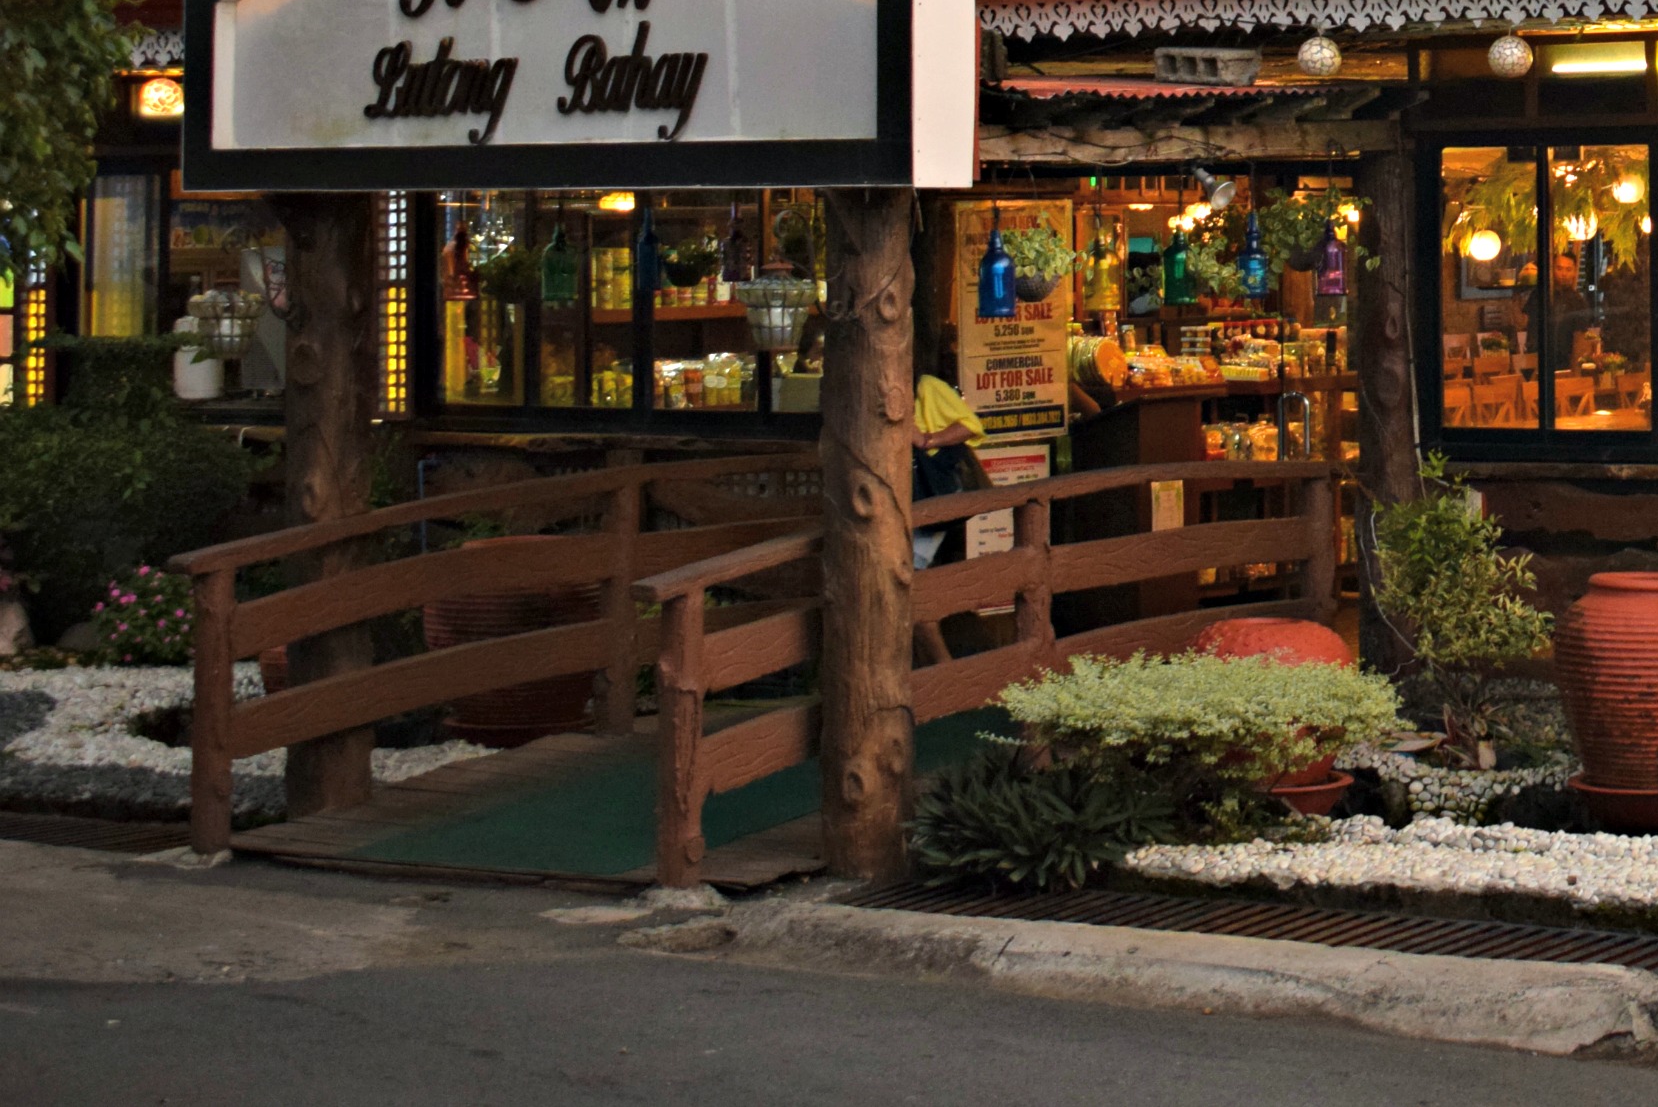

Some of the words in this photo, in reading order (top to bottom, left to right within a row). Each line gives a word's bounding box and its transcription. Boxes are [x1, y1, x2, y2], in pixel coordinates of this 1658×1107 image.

[363, 36, 519, 144] Lutong
[556, 20, 709, 141] Bahay
[1024, 302, 1053, 321] SALE
[986, 355, 1043, 371] COMMERCIAL
[976, 372, 996, 390] LOT
[1000, 369, 1023, 388] FOR
[1025, 367, 1053, 386] SALE
